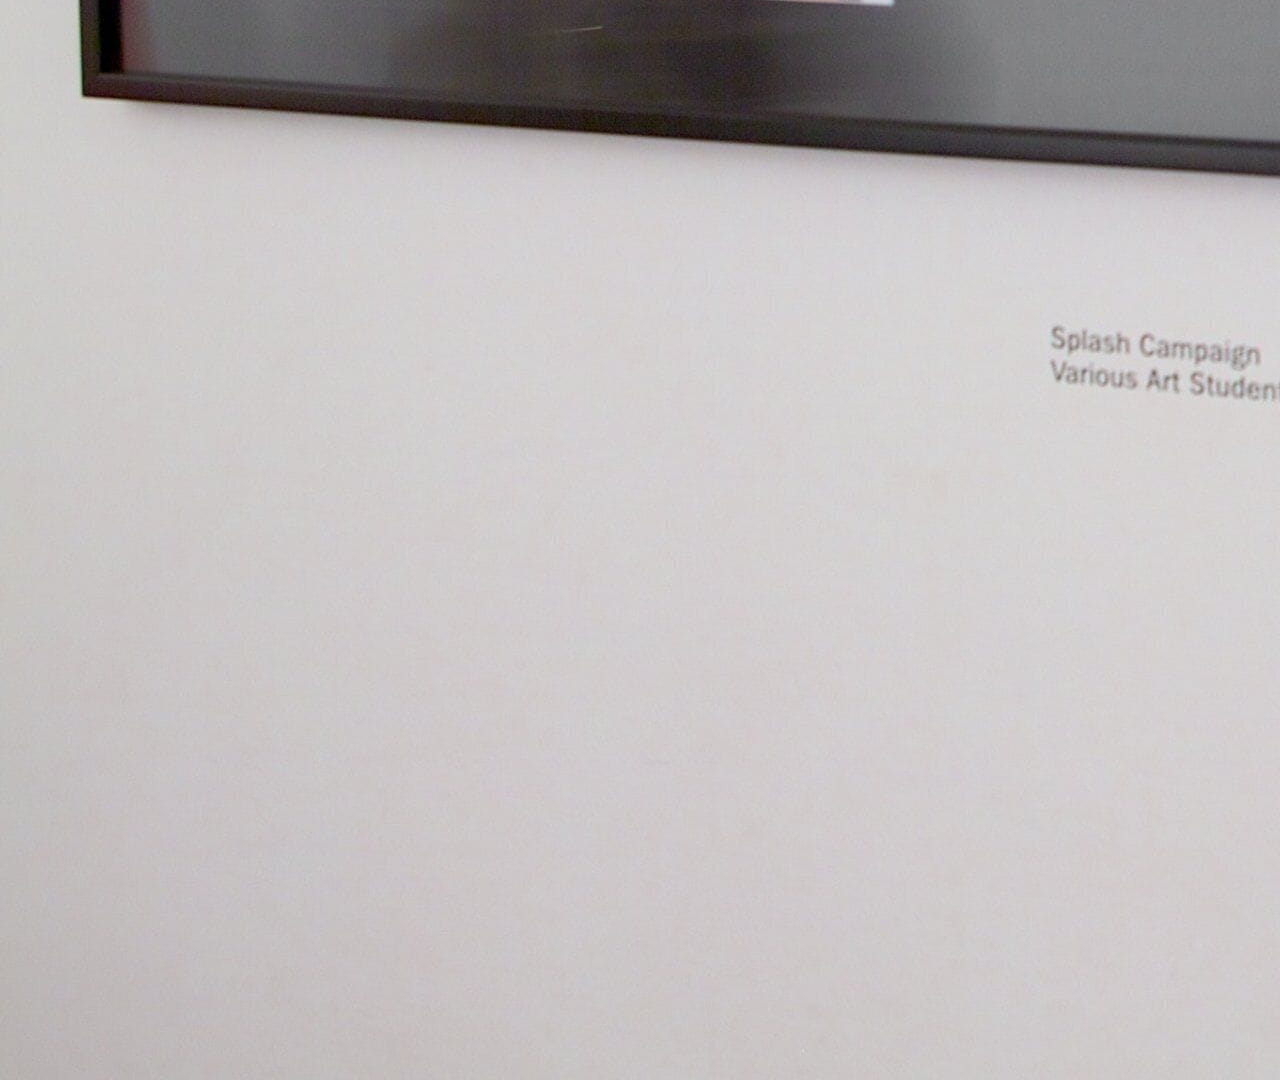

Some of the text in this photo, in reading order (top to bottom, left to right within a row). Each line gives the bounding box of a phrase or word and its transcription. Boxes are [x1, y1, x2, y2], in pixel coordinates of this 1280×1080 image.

[1050, 325, 1263, 370] Splash Campaign
[1050, 360, 1138, 390] Various
[1146, 370, 1180, 394] Art
